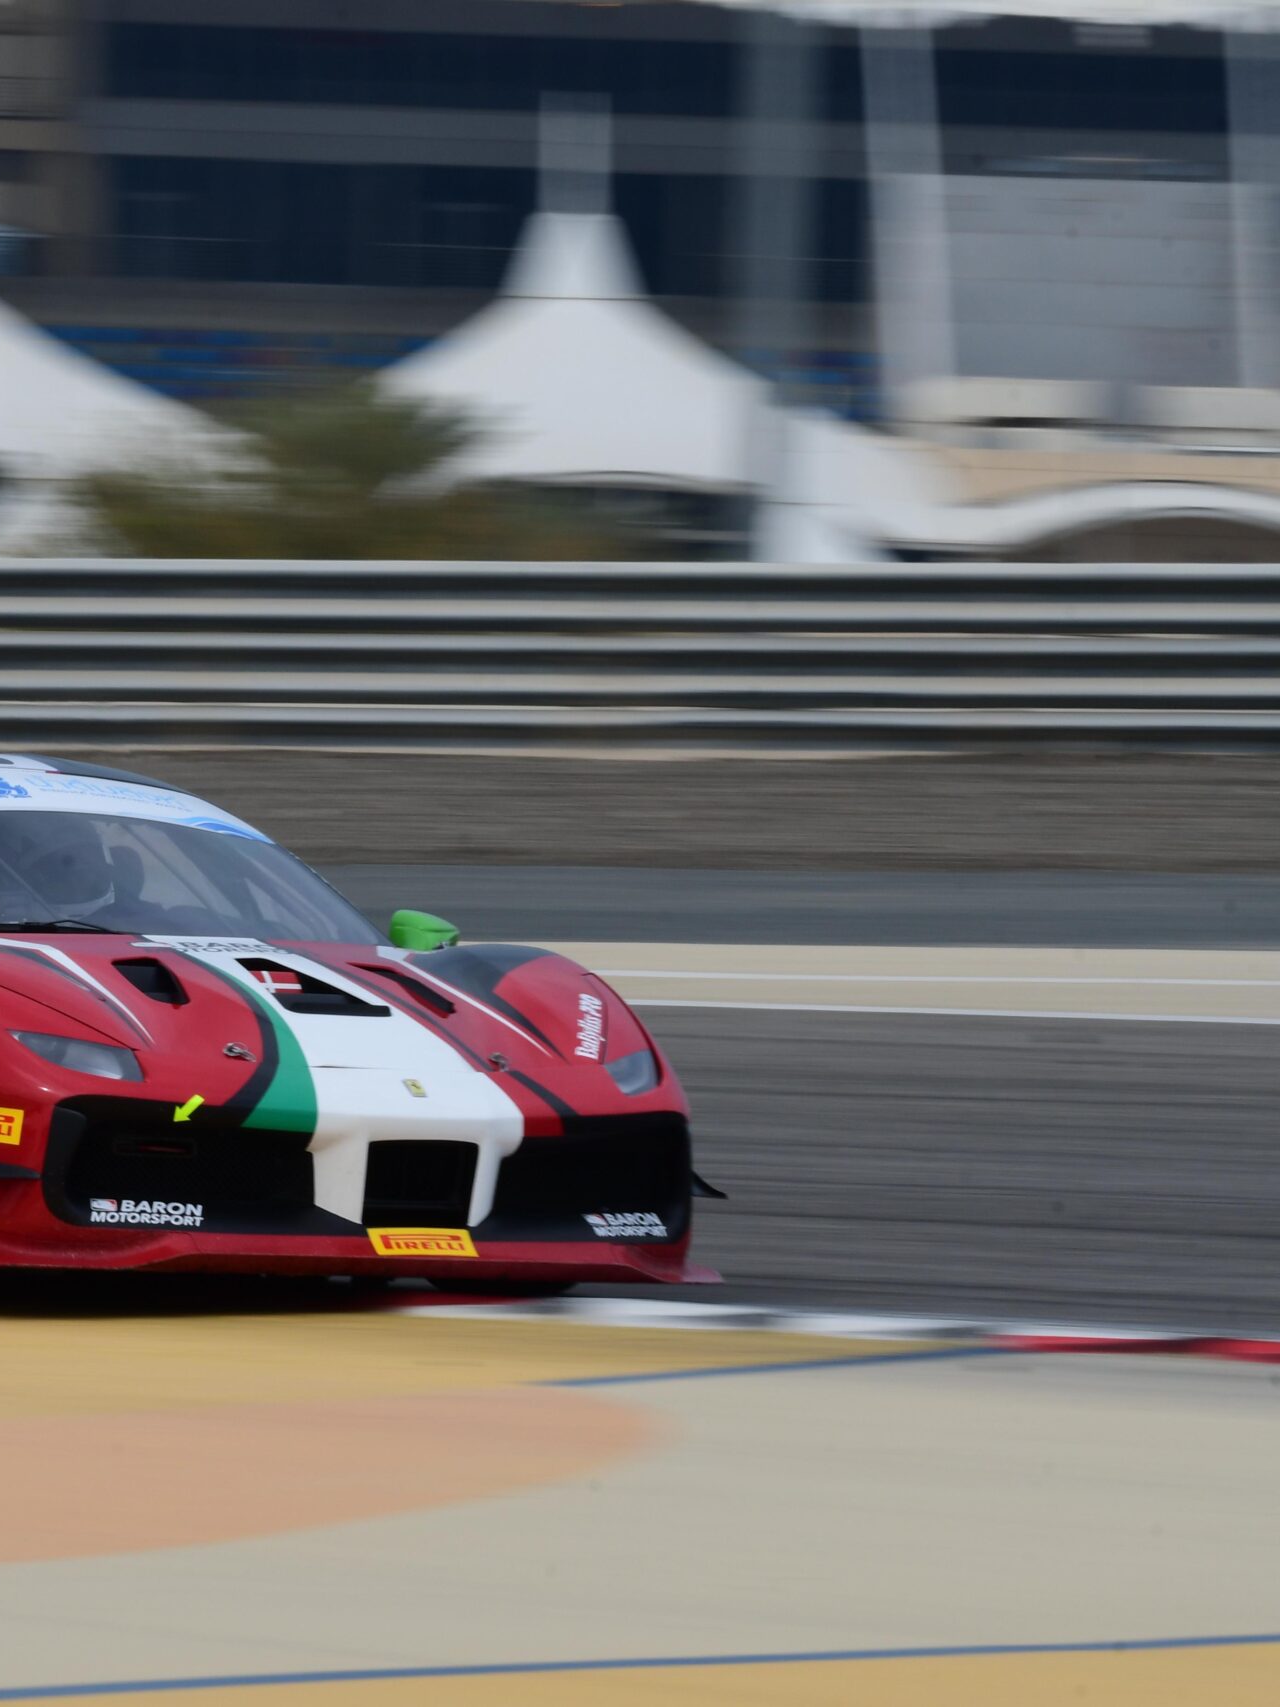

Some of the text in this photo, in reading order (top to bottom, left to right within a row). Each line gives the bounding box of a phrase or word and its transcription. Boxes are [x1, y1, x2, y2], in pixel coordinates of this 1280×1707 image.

[120, 1199, 203, 1217] BARON
[90, 1211, 205, 1228] MOTORSPORT
[603, 1212, 664, 1226] BARON
[592, 1225, 668, 1238] MOTORSPORT
[380, 1234, 466, 1251] PIRELLI
